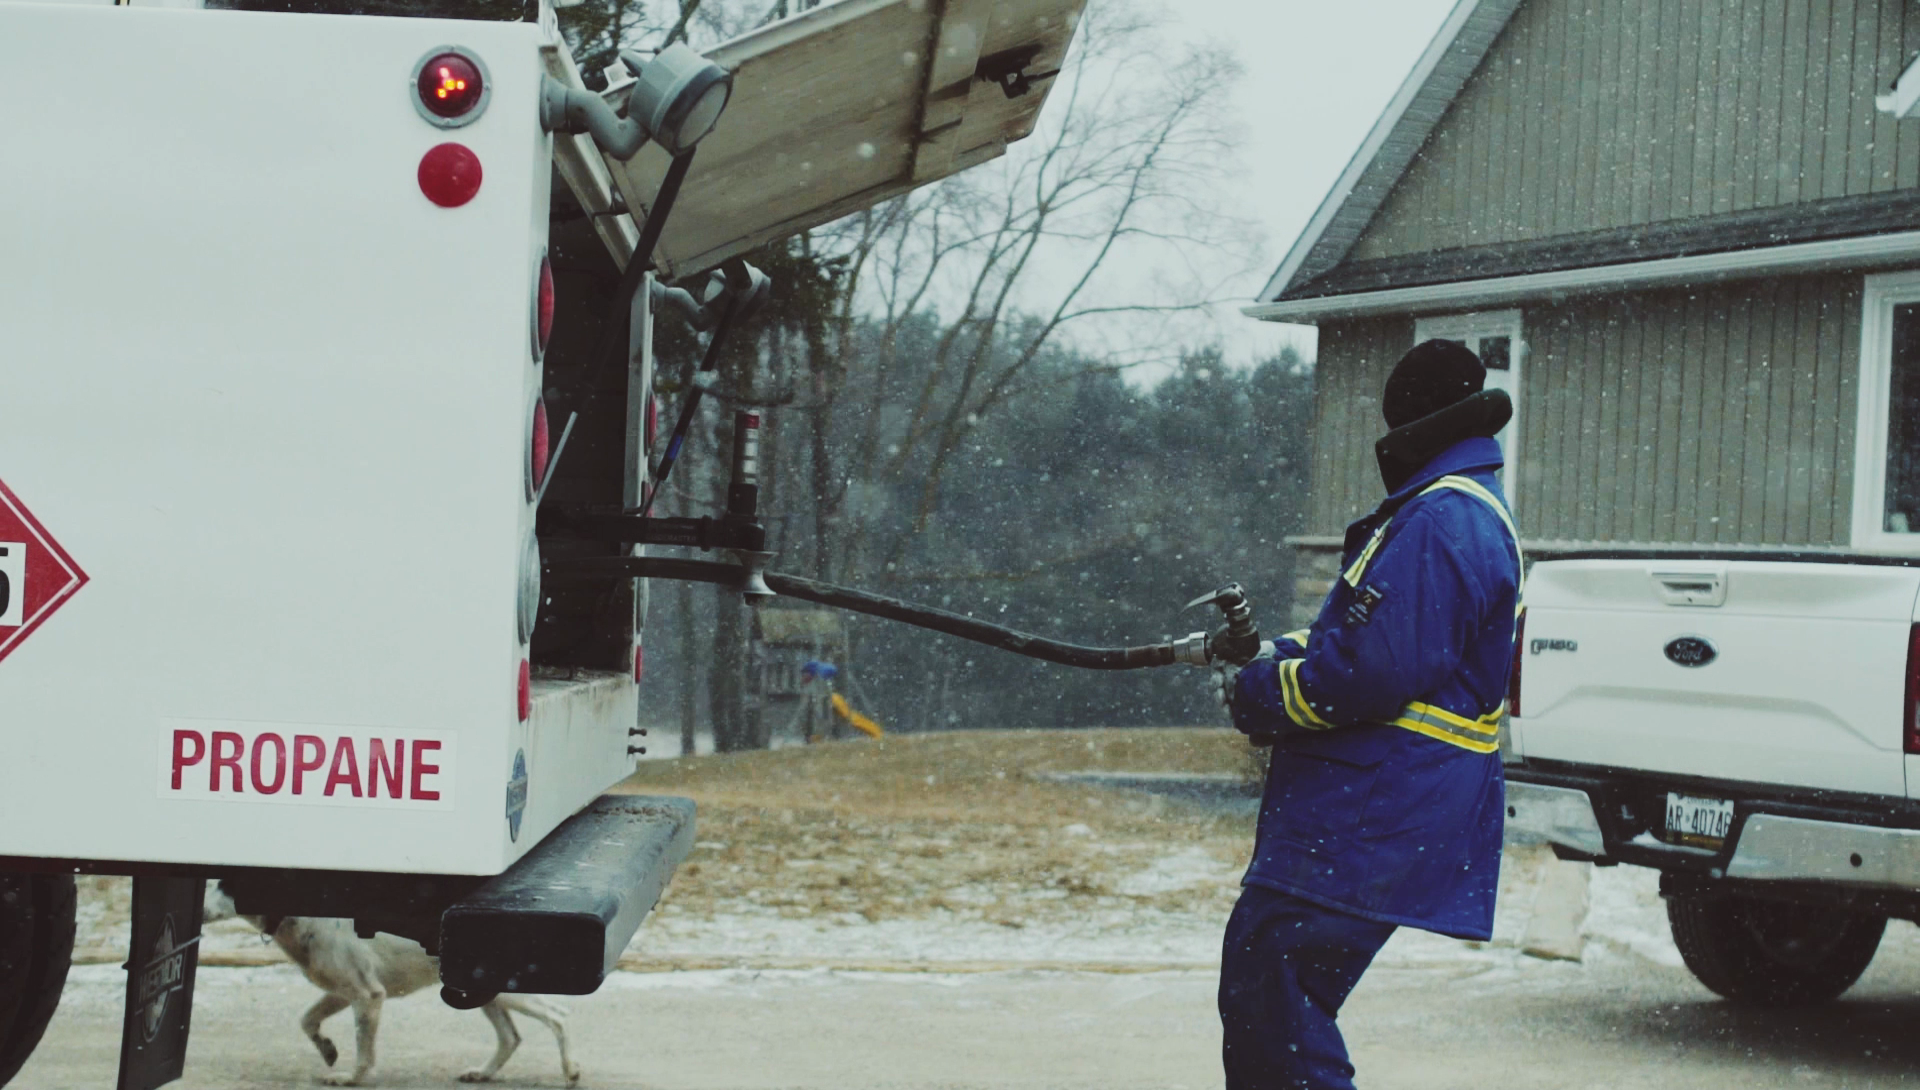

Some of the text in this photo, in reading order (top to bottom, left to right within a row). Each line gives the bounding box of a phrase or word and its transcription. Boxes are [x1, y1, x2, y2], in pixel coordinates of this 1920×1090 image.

[1671, 638, 1706, 662] Ford
[170, 729, 442, 801] PROPANE
[1667, 804, 1683, 833] AR
